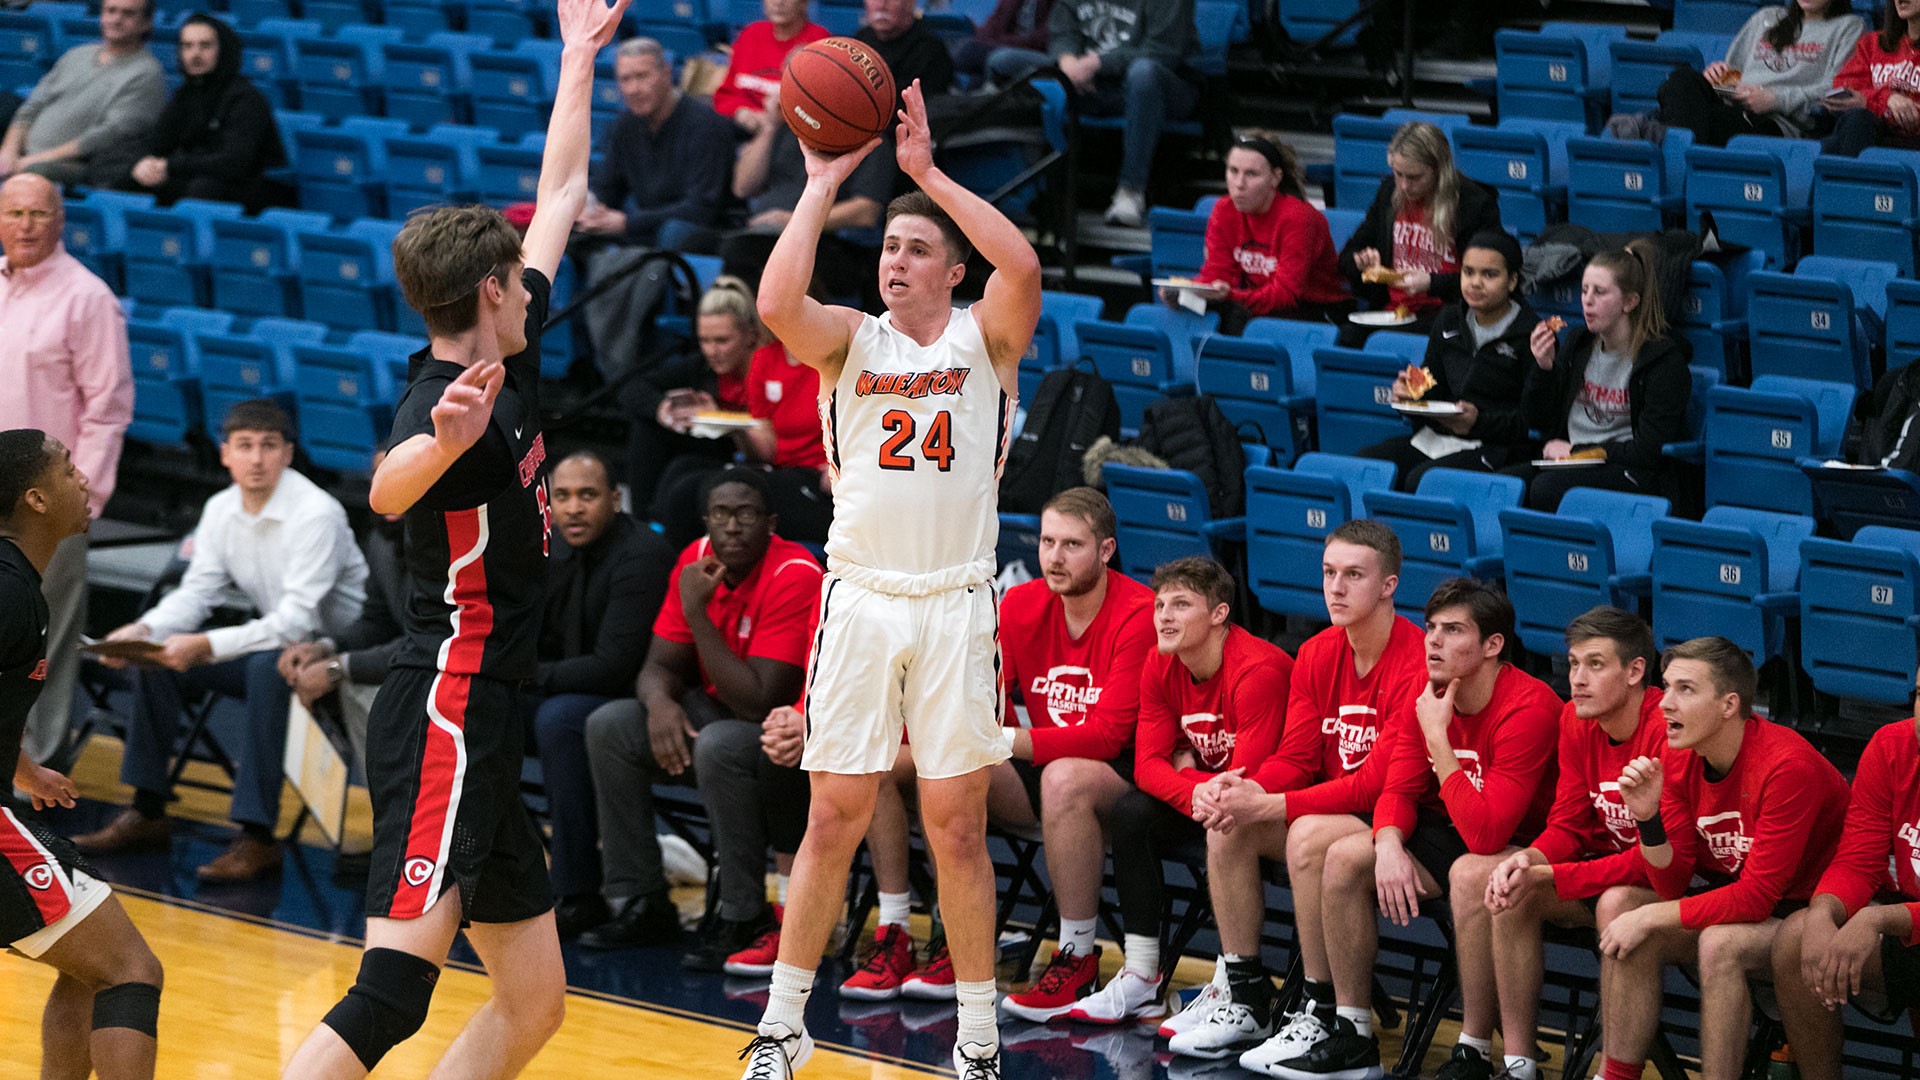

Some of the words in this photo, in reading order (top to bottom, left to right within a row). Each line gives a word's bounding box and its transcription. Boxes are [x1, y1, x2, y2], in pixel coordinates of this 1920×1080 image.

[822, 39, 885, 92] Wilson
[855, 368, 971, 399] WHEATON
[879, 409, 955, 472] 24
[1775, 431, 1788, 447] 35
[1433, 533, 1446, 550] 34
[1571, 553, 1585, 570] 35
[1723, 565, 1737, 582] 36
[1875, 586, 1889, 603] 37
[31, 867, 49, 886] C
[409, 861, 428, 881] C
